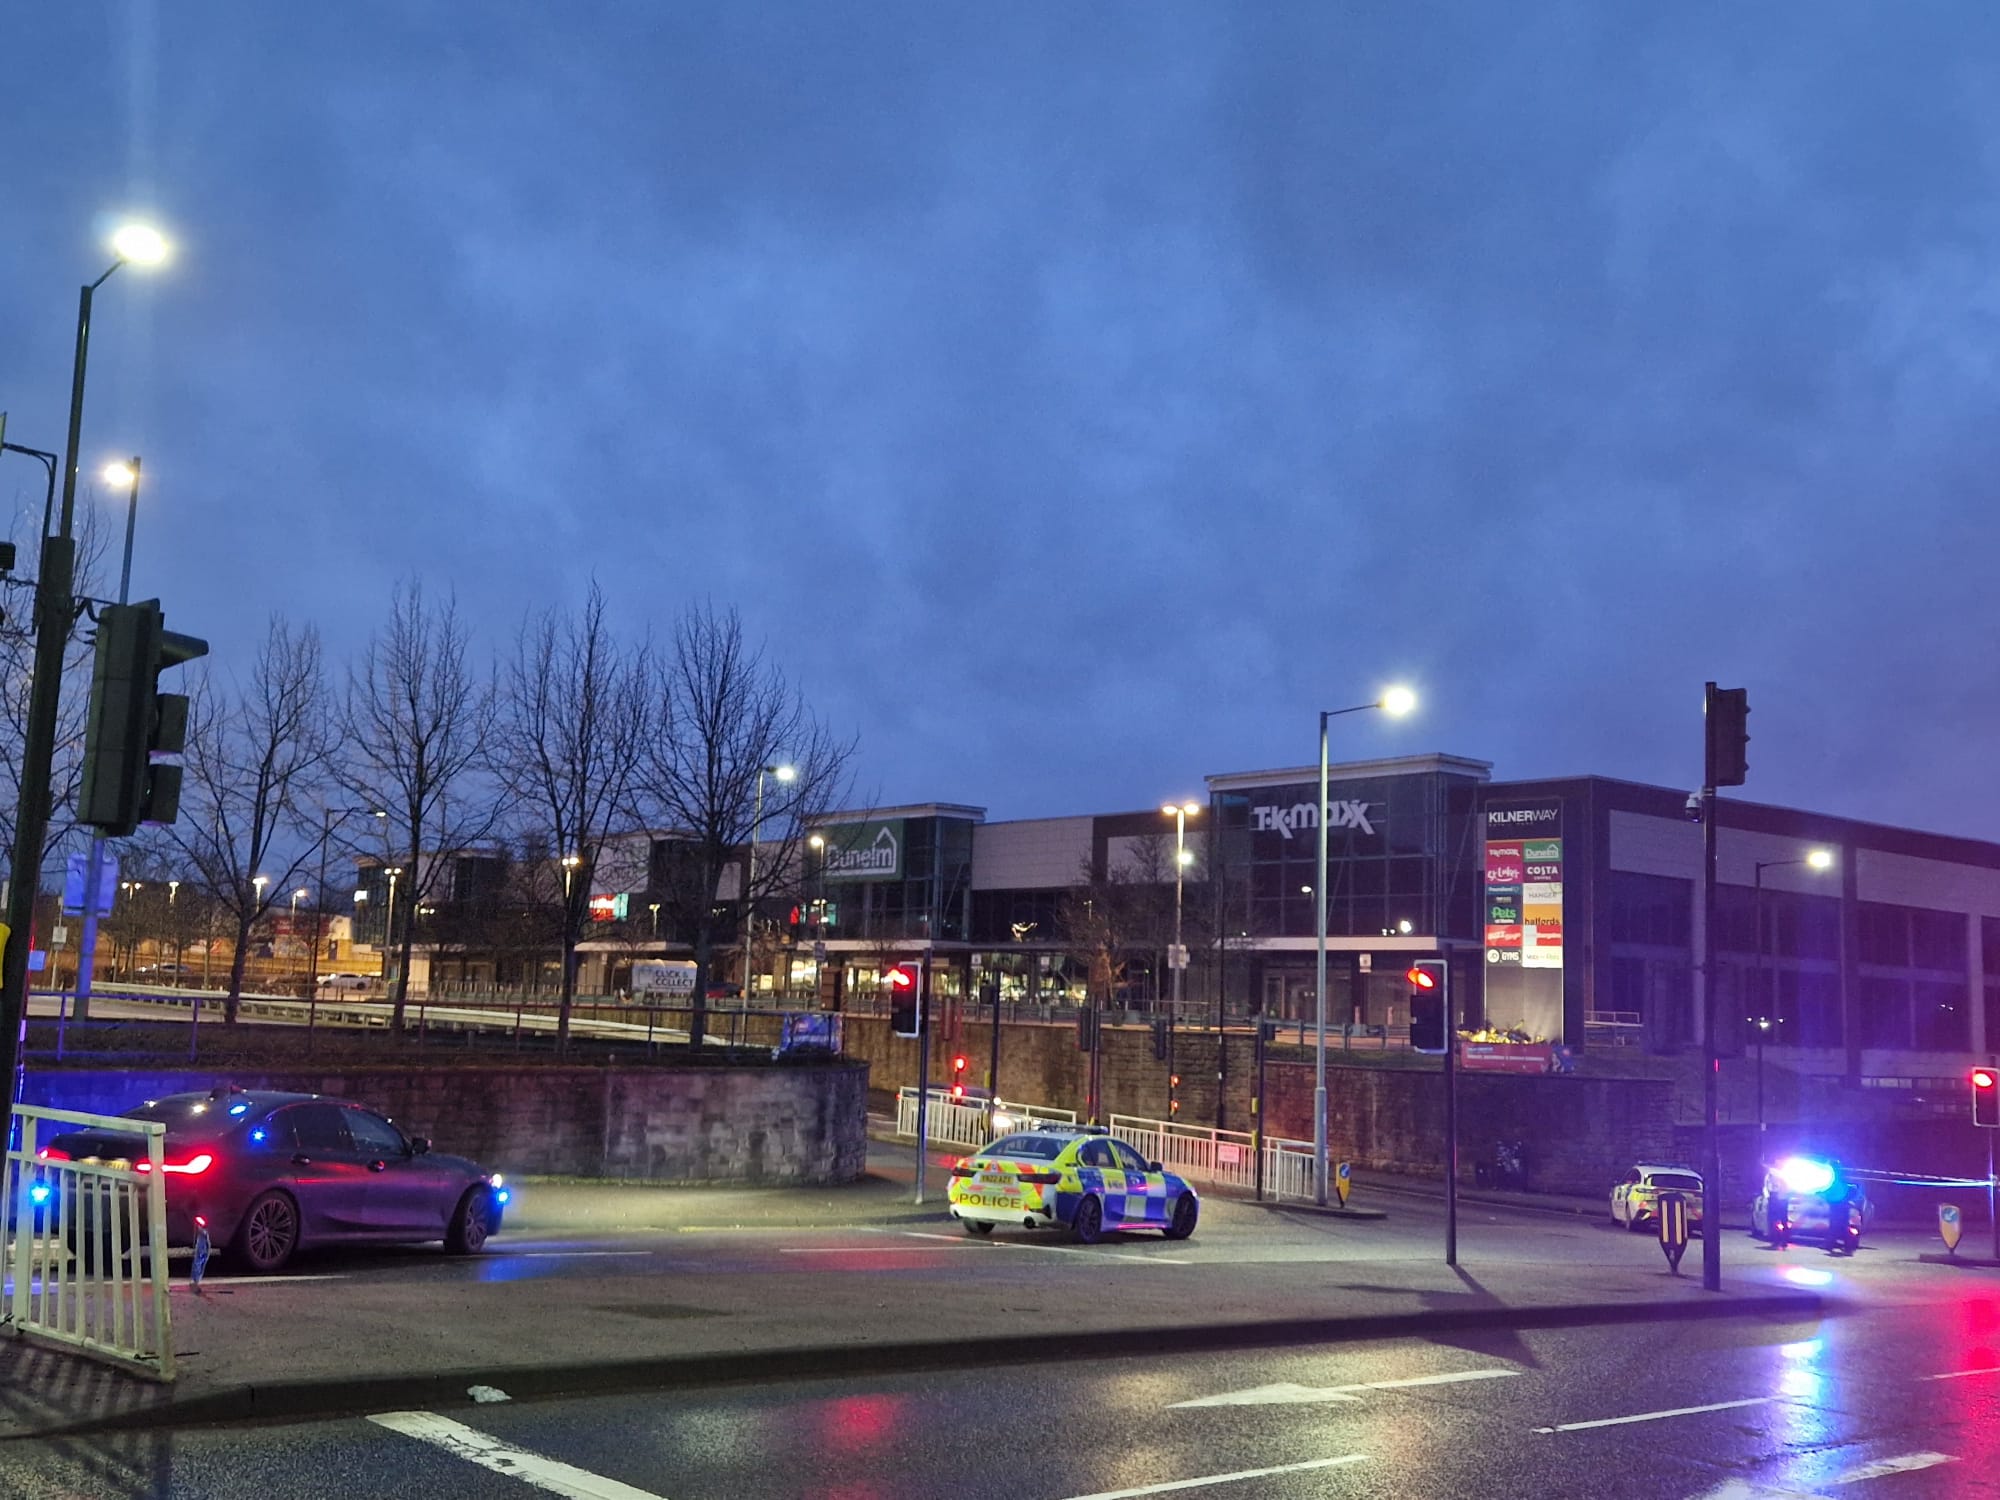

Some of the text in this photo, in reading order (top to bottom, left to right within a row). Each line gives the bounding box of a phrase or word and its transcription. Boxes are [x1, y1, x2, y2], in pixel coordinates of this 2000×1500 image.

[1488, 809, 1558, 823] KILNERWAY
[826, 842, 892, 868] Dunelm
[1527, 866, 1558, 875] COSTA
[1492, 906, 1516, 918] Pets
[1525, 917, 1560, 926] halfords
[655, 978, 694, 987] COLLECT
[960, 1193, 1021, 1209] POLICE
